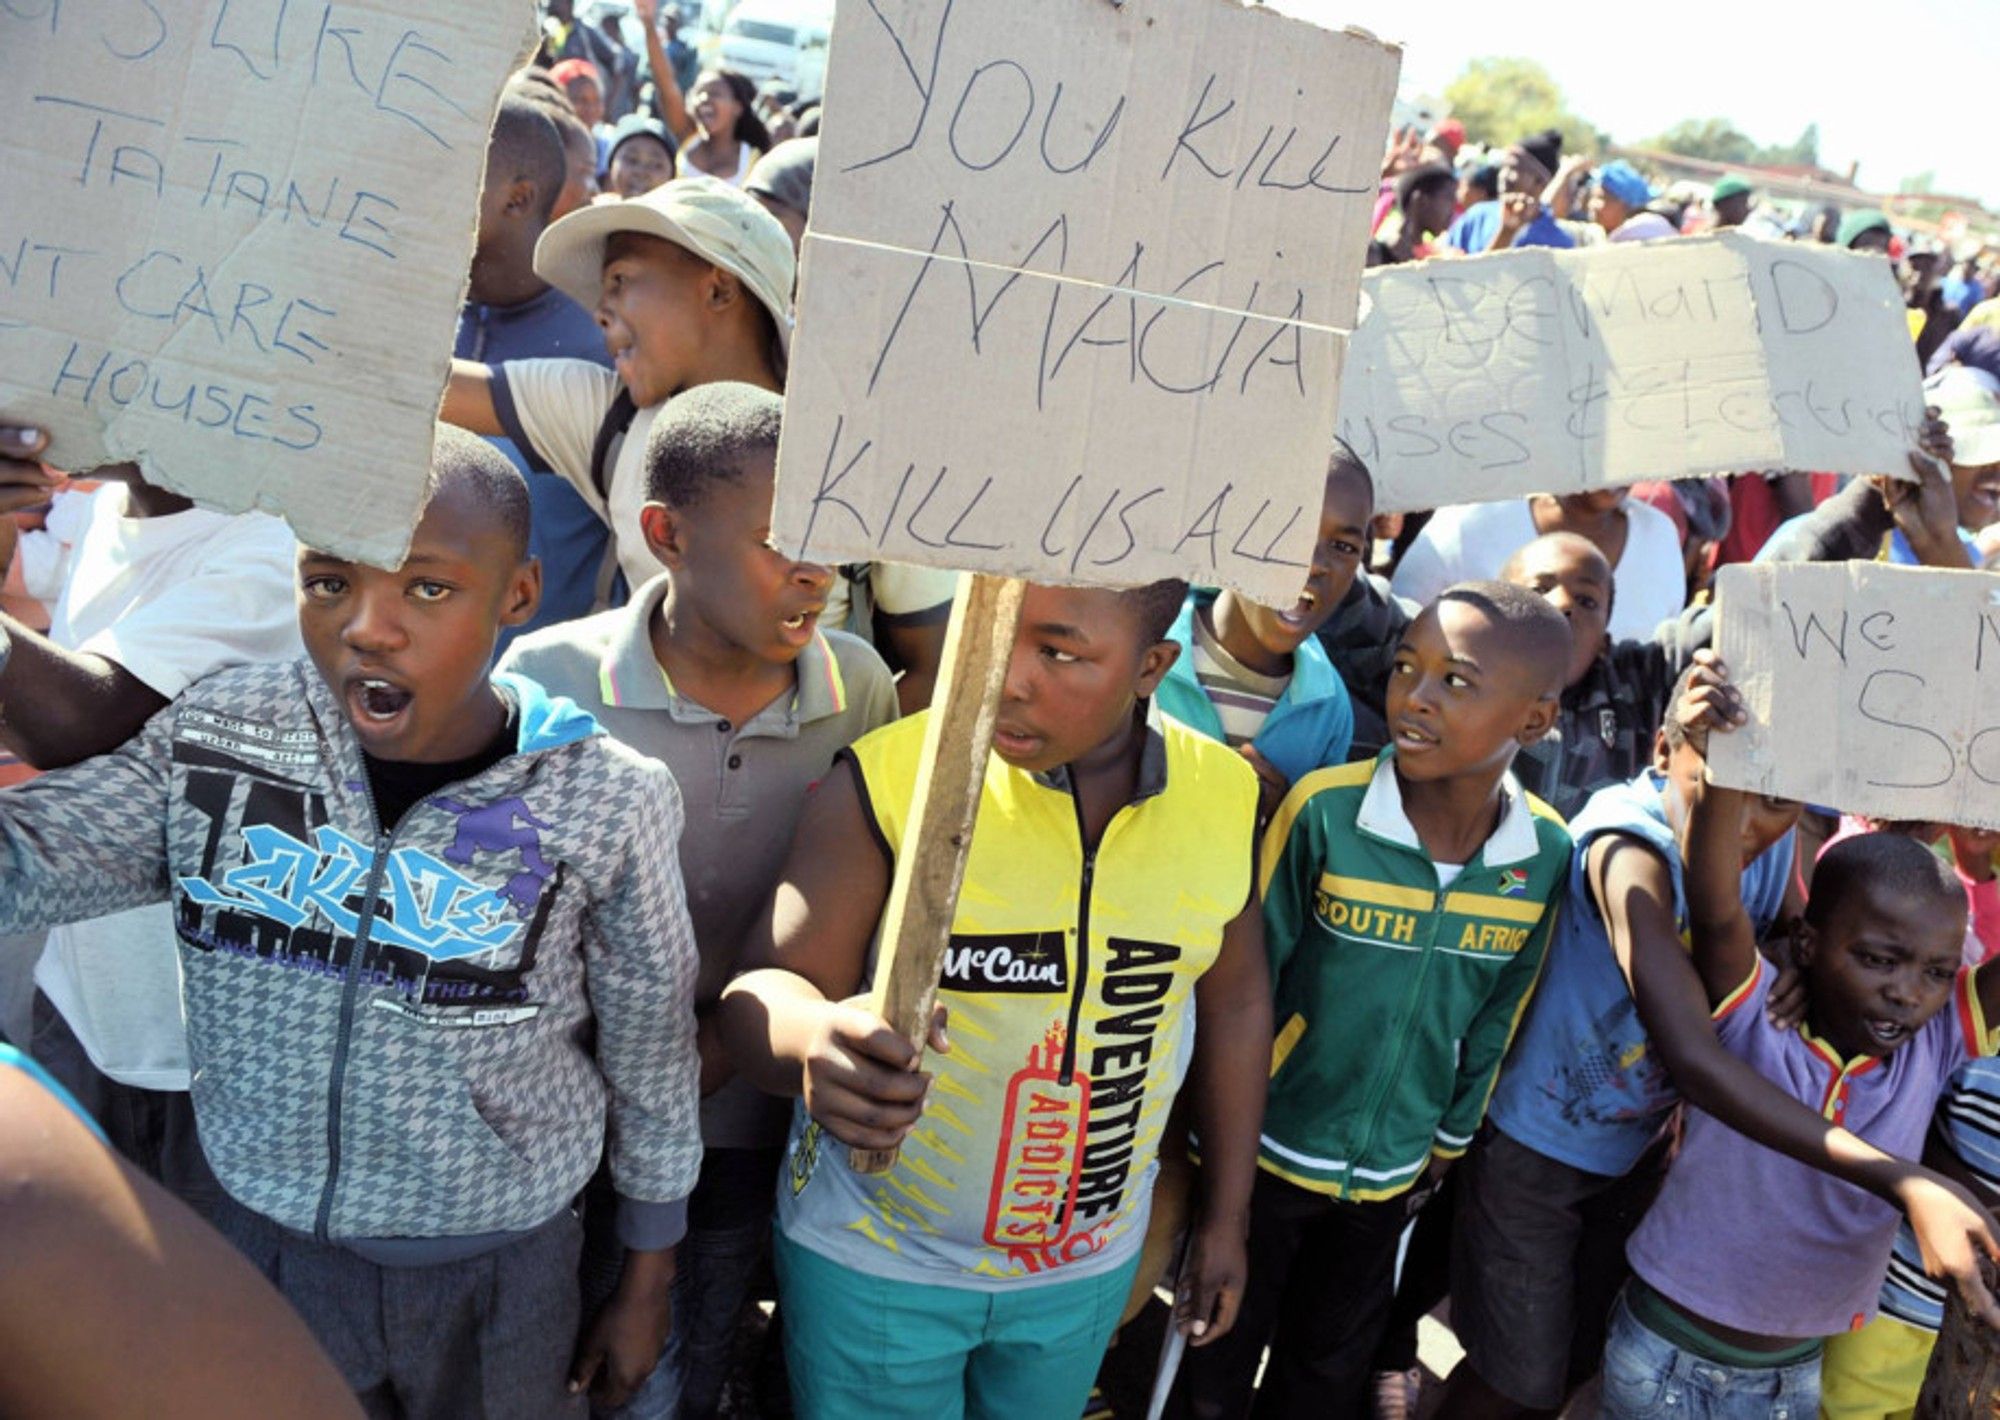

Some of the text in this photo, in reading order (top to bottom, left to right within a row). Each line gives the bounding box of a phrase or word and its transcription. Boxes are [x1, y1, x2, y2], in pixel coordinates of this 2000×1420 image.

[211, 0, 479, 151] LIKE
[841, 0, 1126, 173] YOU
[115, 250, 337, 365] CARE
[52, 341, 324, 451] HOUSES
[799, 414, 1310, 575] KILL US ALL
[1315, 890, 1418, 944] SOUTH
[1054, 936, 1182, 1225] ADVENTURE
[1006, 1092, 1071, 1236] ADDICTS
